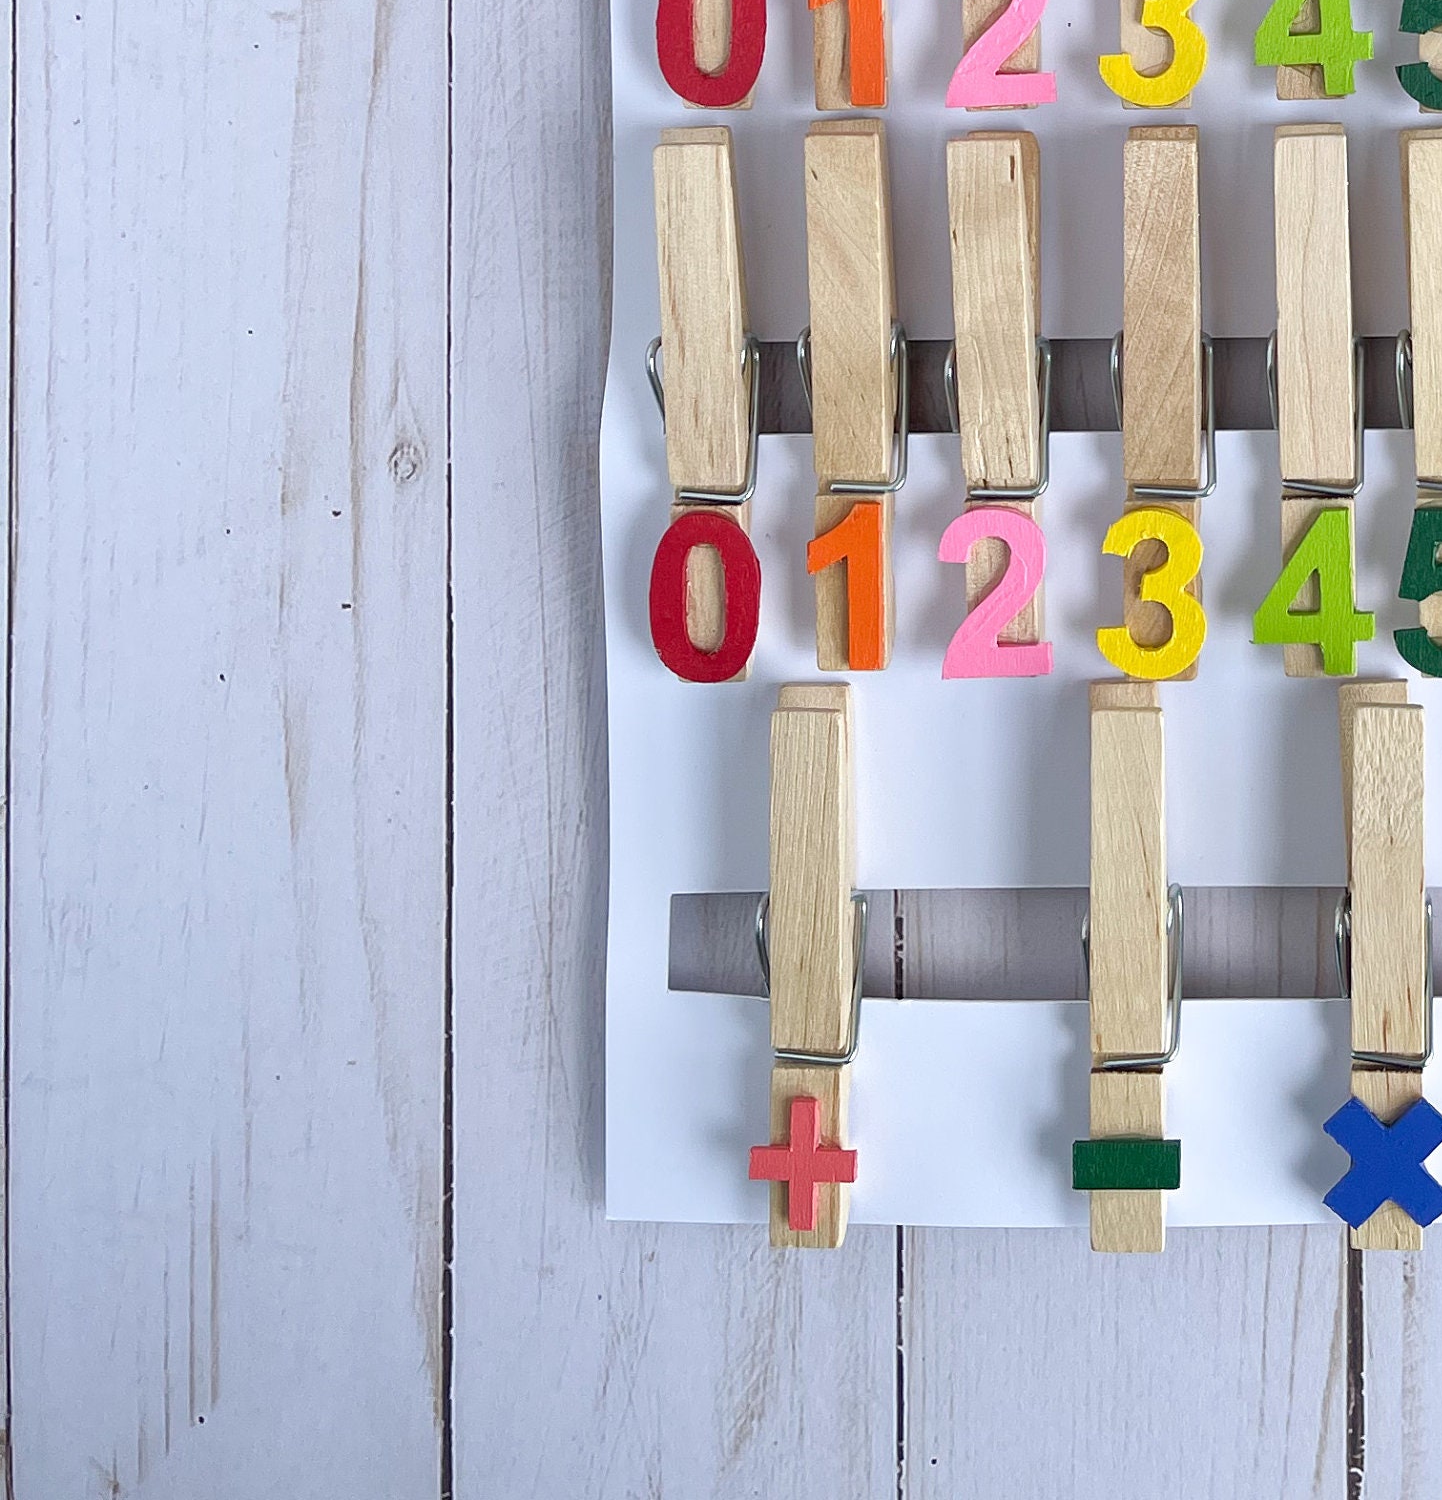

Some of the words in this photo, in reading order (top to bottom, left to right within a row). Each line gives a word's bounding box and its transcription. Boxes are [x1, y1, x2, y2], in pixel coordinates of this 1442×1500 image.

[650, 514, 761, 682] 0
[809, 502, 880, 668] 1
[939, 506, 1052, 678] 2
[1097, 506, 1205, 680] 3
[1255, 508, 1373, 674] 4
